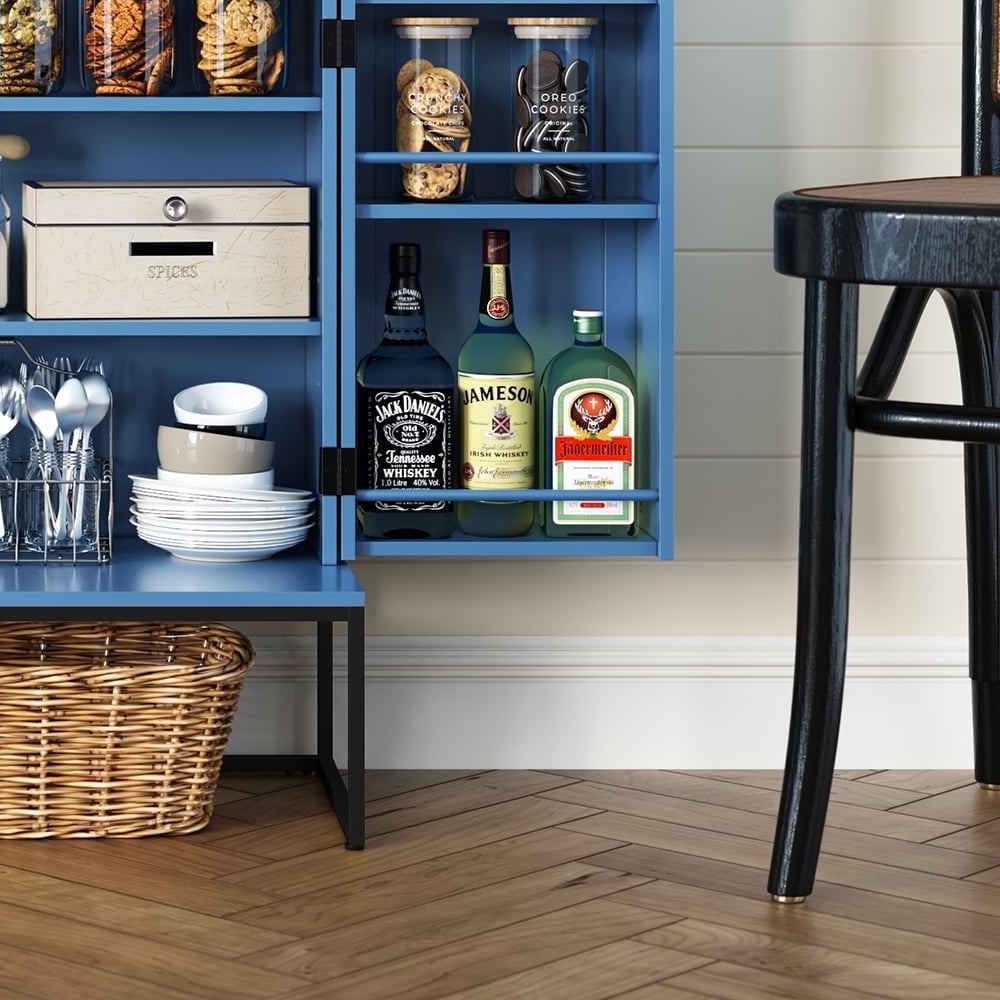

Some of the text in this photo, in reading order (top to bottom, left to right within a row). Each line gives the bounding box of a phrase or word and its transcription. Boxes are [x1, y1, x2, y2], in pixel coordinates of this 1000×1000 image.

[409, 93, 467, 102] CRUNCHY
[541, 93, 577, 102] OREO
[410, 104, 465, 114] COOKIES
[531, 104, 585, 114] COOKIES
[148, 265, 198, 279] SPICES
[463, 386, 533, 405] JAMESON
[375, 395, 446, 423] JACK DANIEL'S
[386, 450, 435, 463] Tennessee
[383, 468, 437, 478] WHISKEY
[393, 479, 408, 487] Litre
[413, 479, 428, 487] 40%
[428, 479, 441, 487] Vol.
